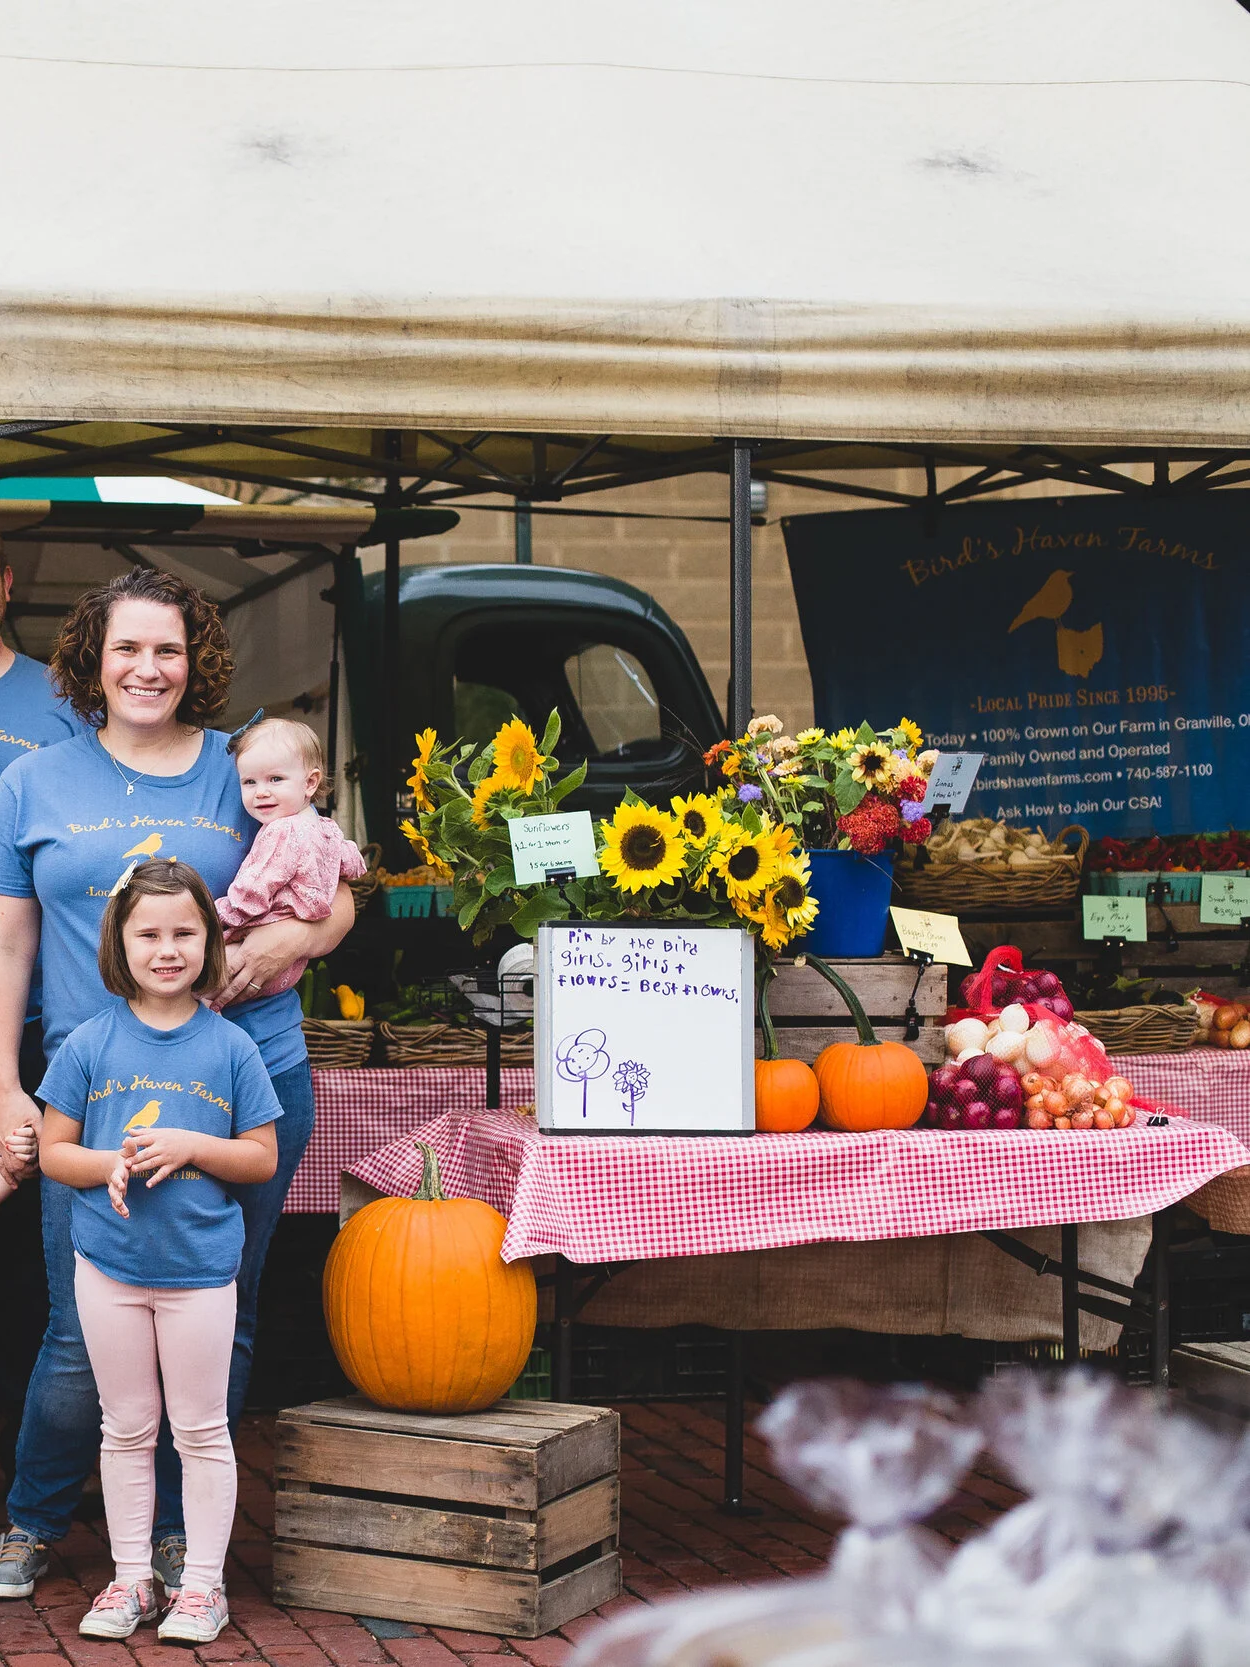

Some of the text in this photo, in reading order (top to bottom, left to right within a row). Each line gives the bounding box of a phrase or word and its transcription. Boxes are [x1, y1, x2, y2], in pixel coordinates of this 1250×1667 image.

[901, 525, 1223, 587] Bird's Haven Farms
[925, 733, 966, 748] Today
[982, 727, 1020, 743] 100%
[1025, 725, 1069, 740] Grown
[1072, 725, 1088, 737] on
[1092, 721, 1117, 736] Our
[1120, 720, 1155, 734] Farm
[1159, 718, 1170, 731] in
[1174, 715, 1235, 730] Granville,
[982, 742, 1170, 767] Family Owned and Operated
[1126, 763, 1213, 780] 740-587-1100
[997, 796, 1162, 819] Ask How to Join Our CSA!
[66, 815, 242, 842] Bird's Haven Farms
[523, 822, 571, 833] Sunflowers
[601, 934, 616, 945] by
[629, 937, 654, 950] the
[88, 1079, 127, 1103] ird's
[130, 1074, 184, 1092] Haven
